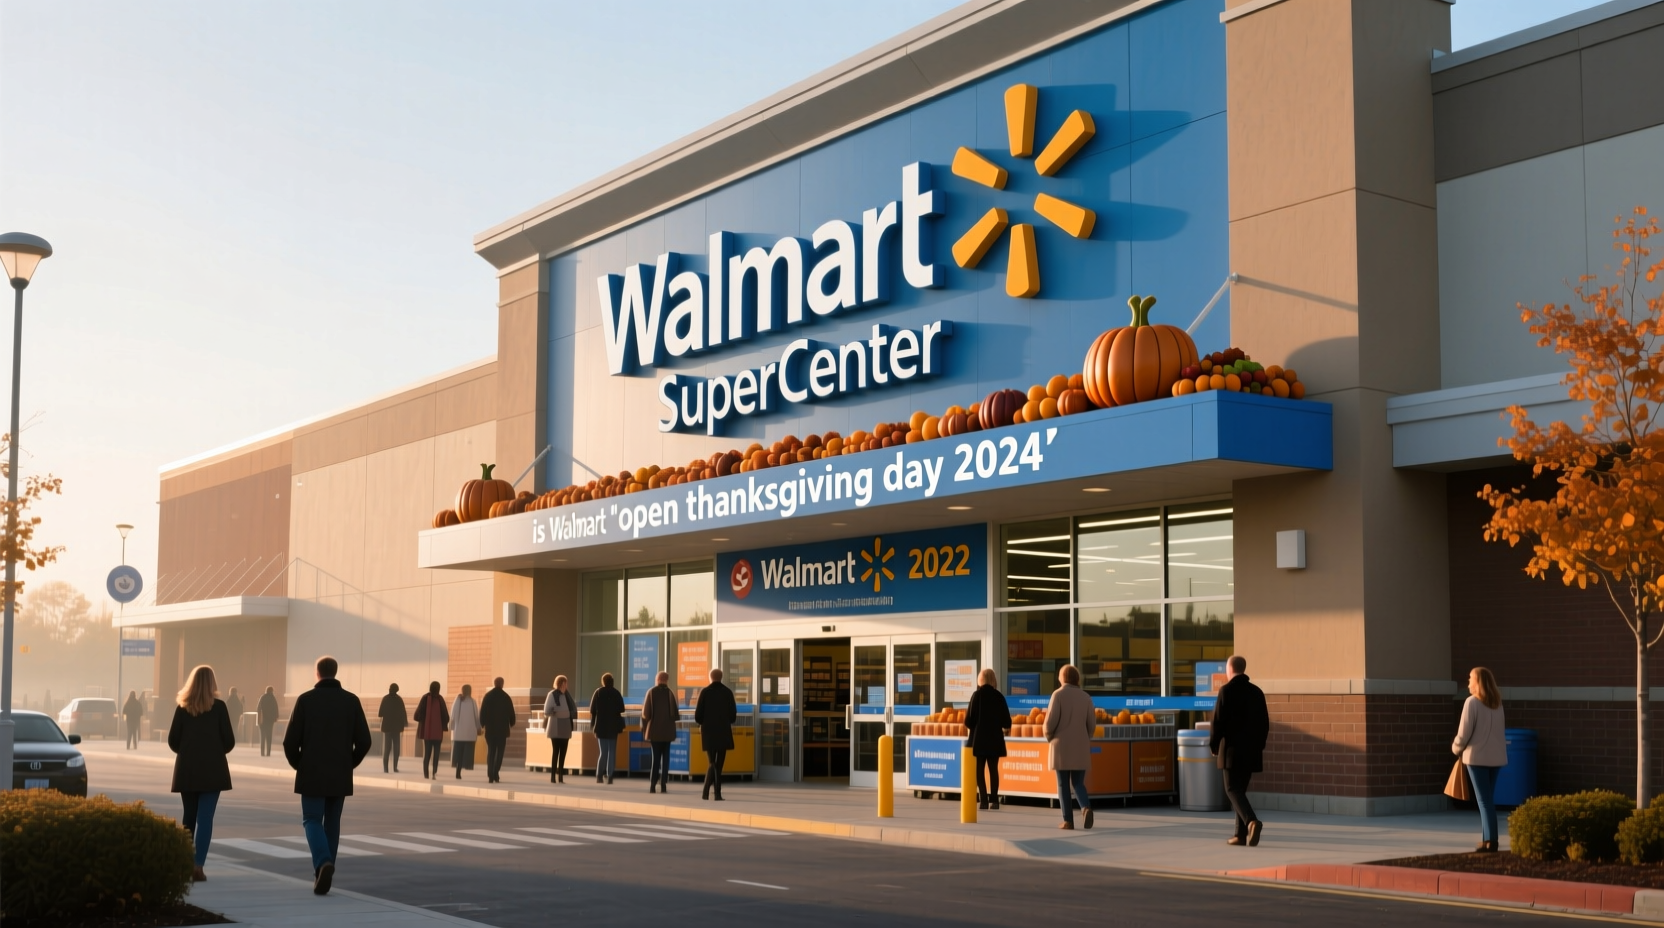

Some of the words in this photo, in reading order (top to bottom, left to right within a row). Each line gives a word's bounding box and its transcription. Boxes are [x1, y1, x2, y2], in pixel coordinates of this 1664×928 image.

[598, 161, 939, 375] Walmart
[659, 320, 945, 436] SuperCenter
[533, 519, 546, 543] is
[611, 500, 678, 537] "open
[686, 464, 873, 521] thanksgiving
[883, 451, 943, 498] day
[761, 551, 855, 590] Walmart
[909, 544, 970, 579] 2022
